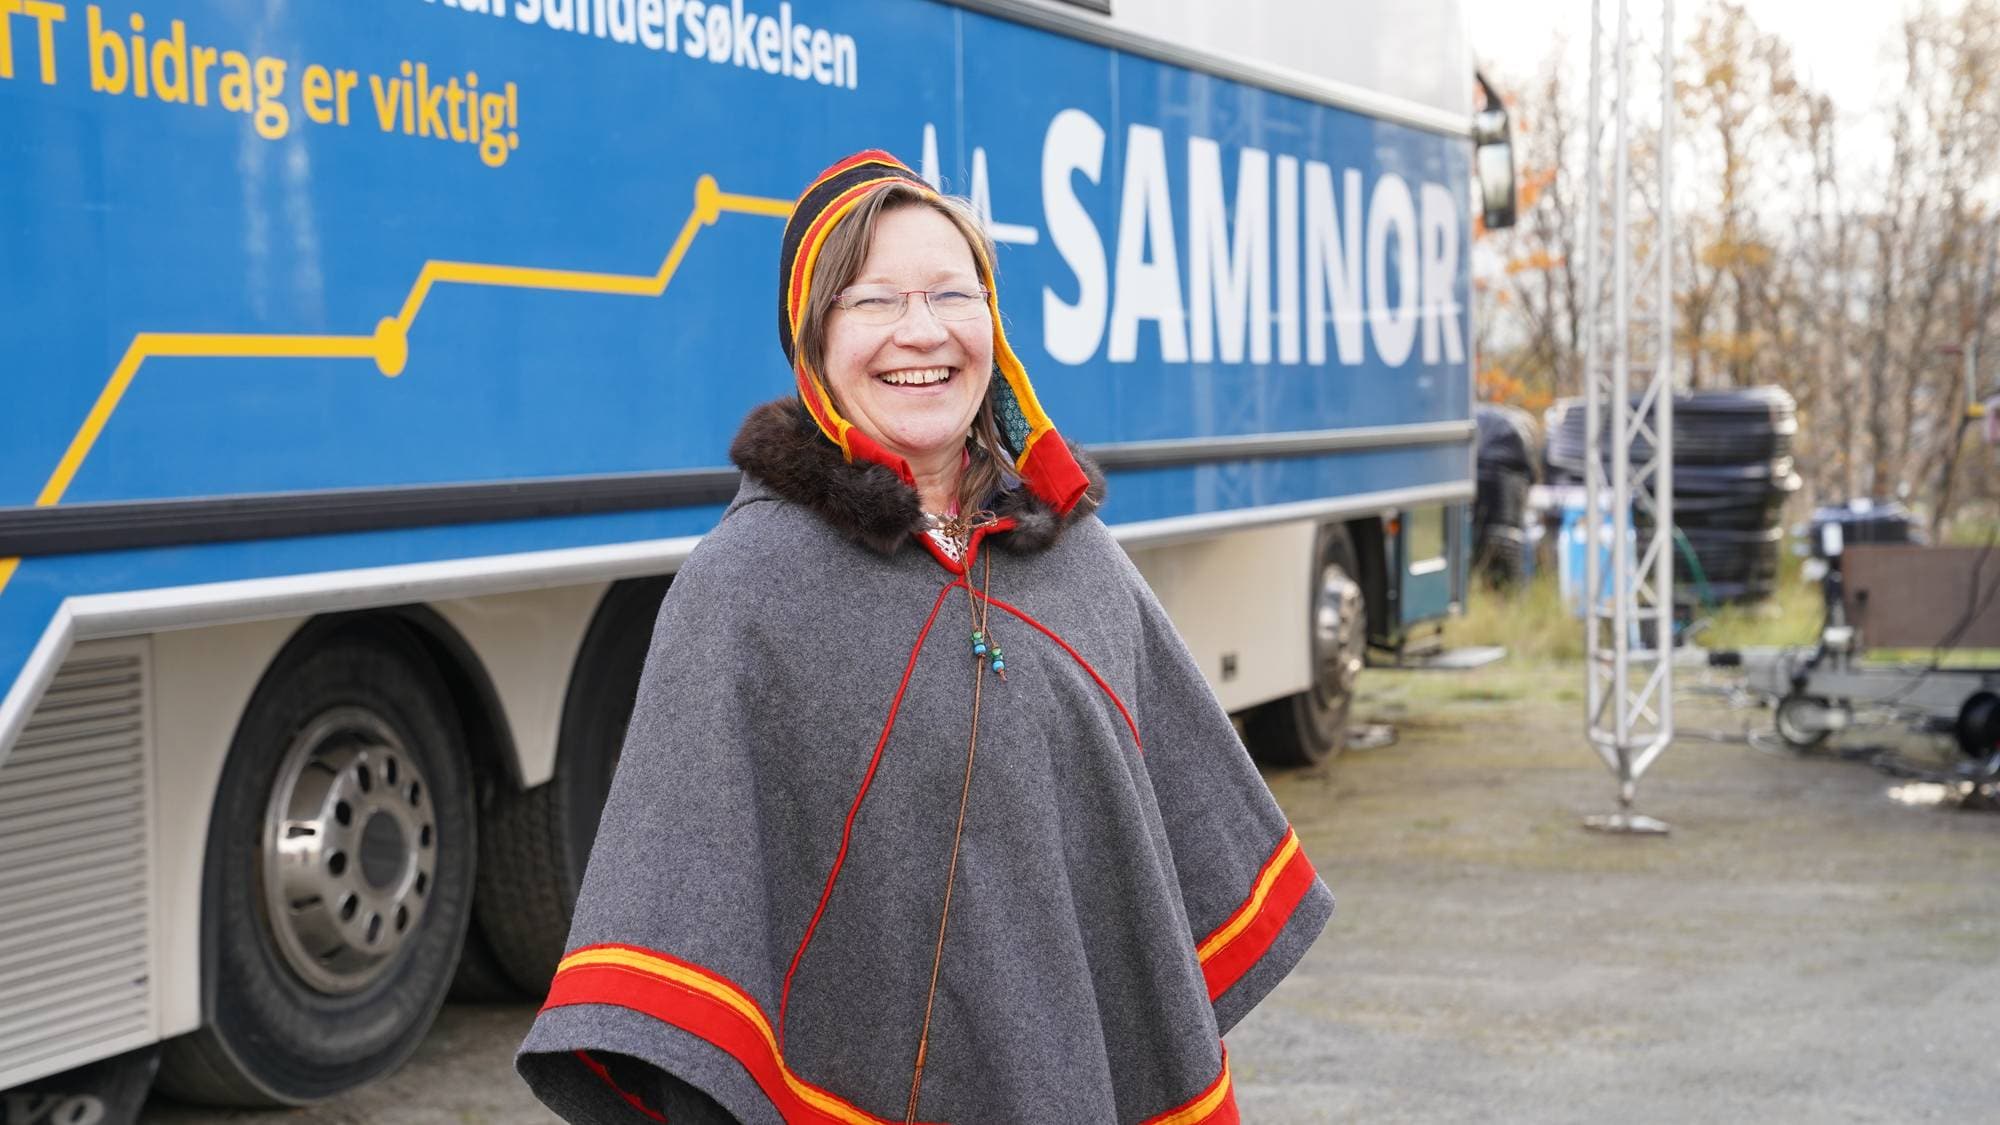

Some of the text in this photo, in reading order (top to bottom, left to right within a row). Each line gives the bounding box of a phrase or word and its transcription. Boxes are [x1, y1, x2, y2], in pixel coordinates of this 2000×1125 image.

[86, 4, 289, 140] bidrag
[302, 64, 358, 126] er
[369, 60, 519, 167] viktig!
[1042, 108, 1465, 366] SAMINOR
